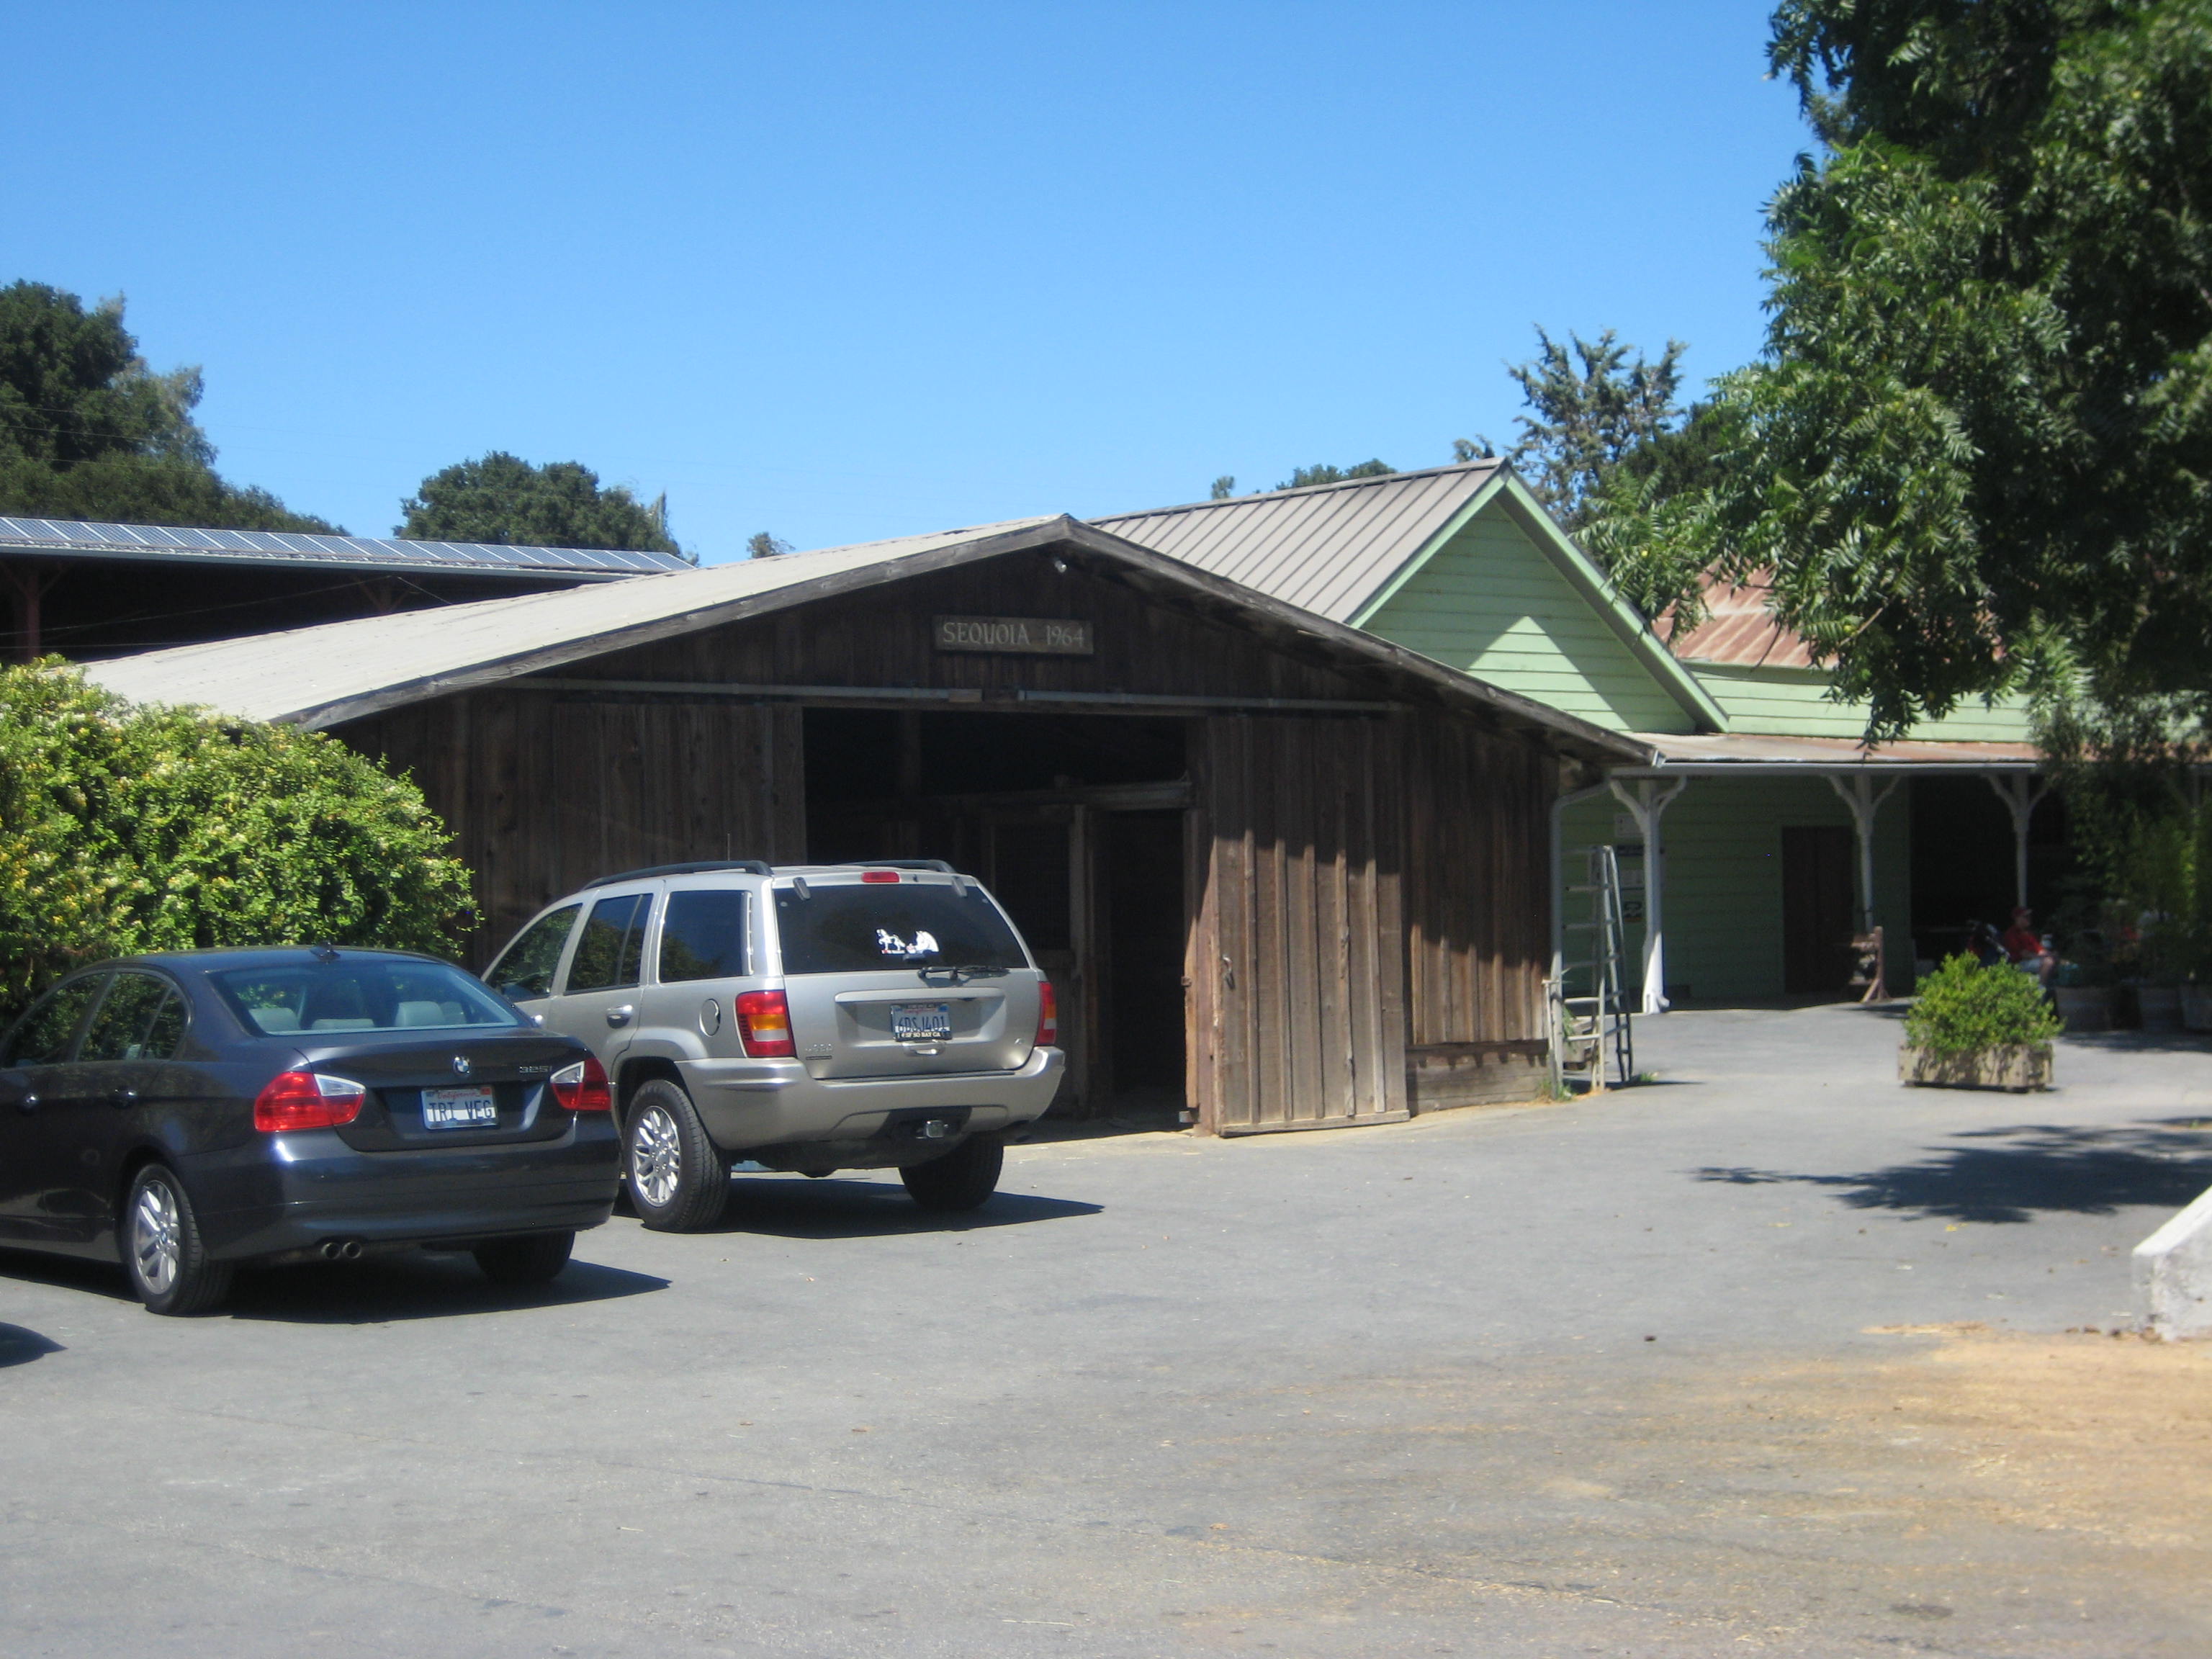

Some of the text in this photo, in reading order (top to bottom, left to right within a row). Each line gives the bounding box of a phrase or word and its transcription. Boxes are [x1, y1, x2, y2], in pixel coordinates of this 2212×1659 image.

[943, 621, 1084, 647] SEQUOIA 1964
[464, 1100, 493, 1121] VEG
